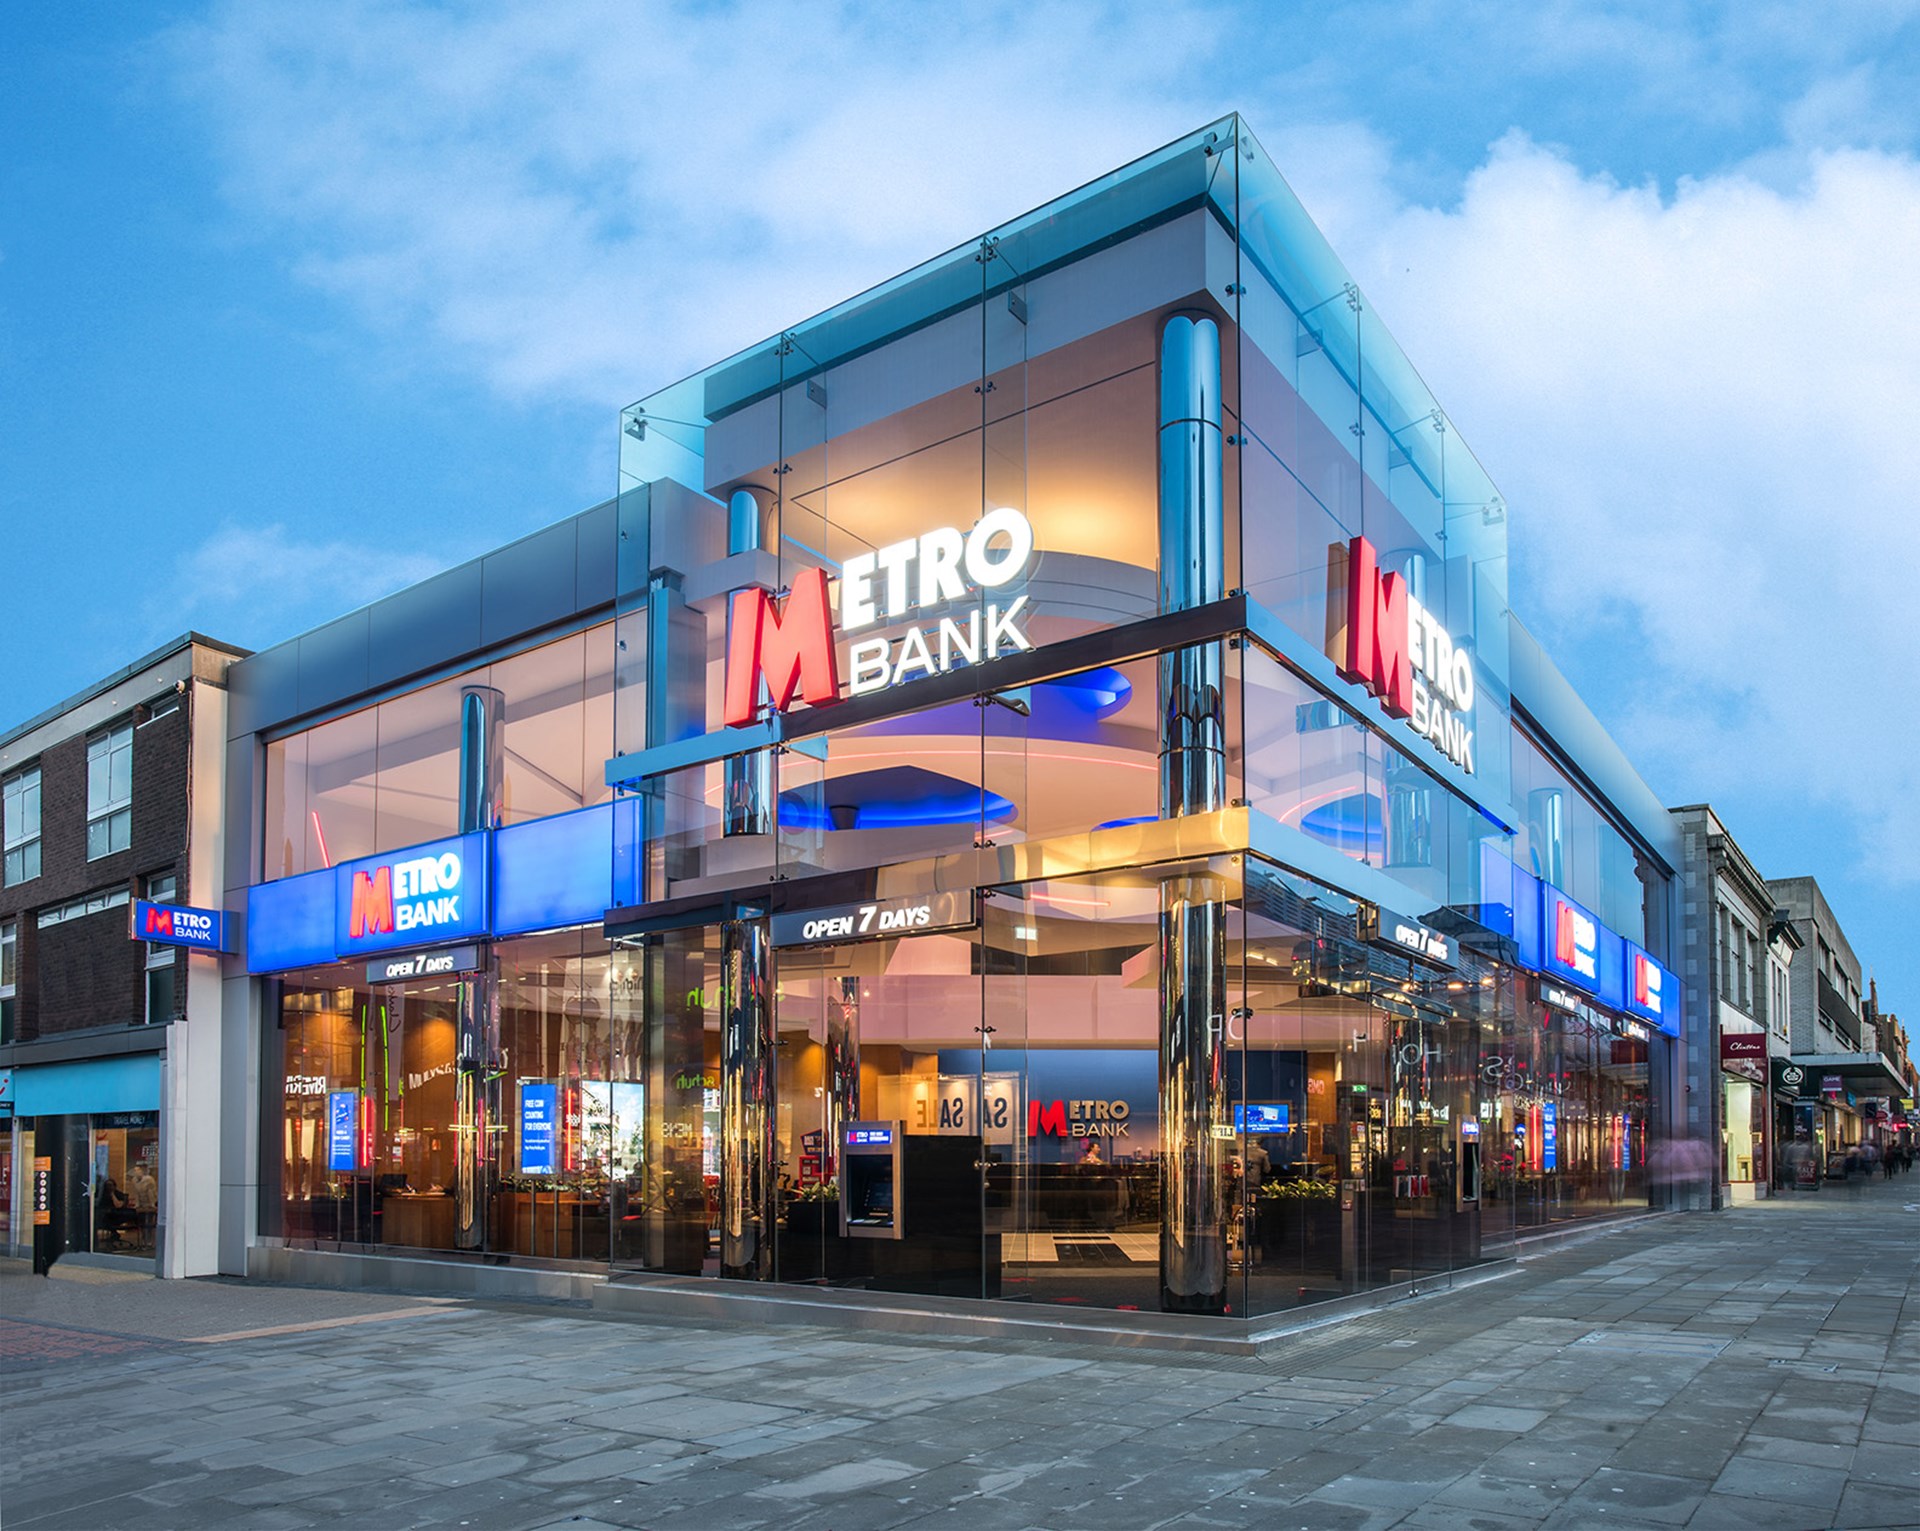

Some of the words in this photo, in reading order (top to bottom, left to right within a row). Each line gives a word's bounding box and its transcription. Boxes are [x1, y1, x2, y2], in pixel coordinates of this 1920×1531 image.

[725, 507, 1034, 728] METRO
[1346, 535, 1473, 719] METRO
[850, 595, 1033, 697] BANK
[1408, 677, 1474, 774] BANK
[350, 852, 460, 938] METRO
[396, 895, 459, 931] BANK
[146, 907, 212, 935] METRO
[175, 927, 211, 940] BANK
[803, 916, 853, 939] OPEN
[858, 906, 877, 932] 7
[879, 906, 930, 929] DAYS
[1419, 928, 1429, 951] 7
[386, 961, 414, 977] OPEN
[415, 955, 426, 973] 7
[426, 956, 454, 972] DAYS
[1028, 1100, 1130, 1137] METRO
[1072, 1122, 1130, 1138] BANK
